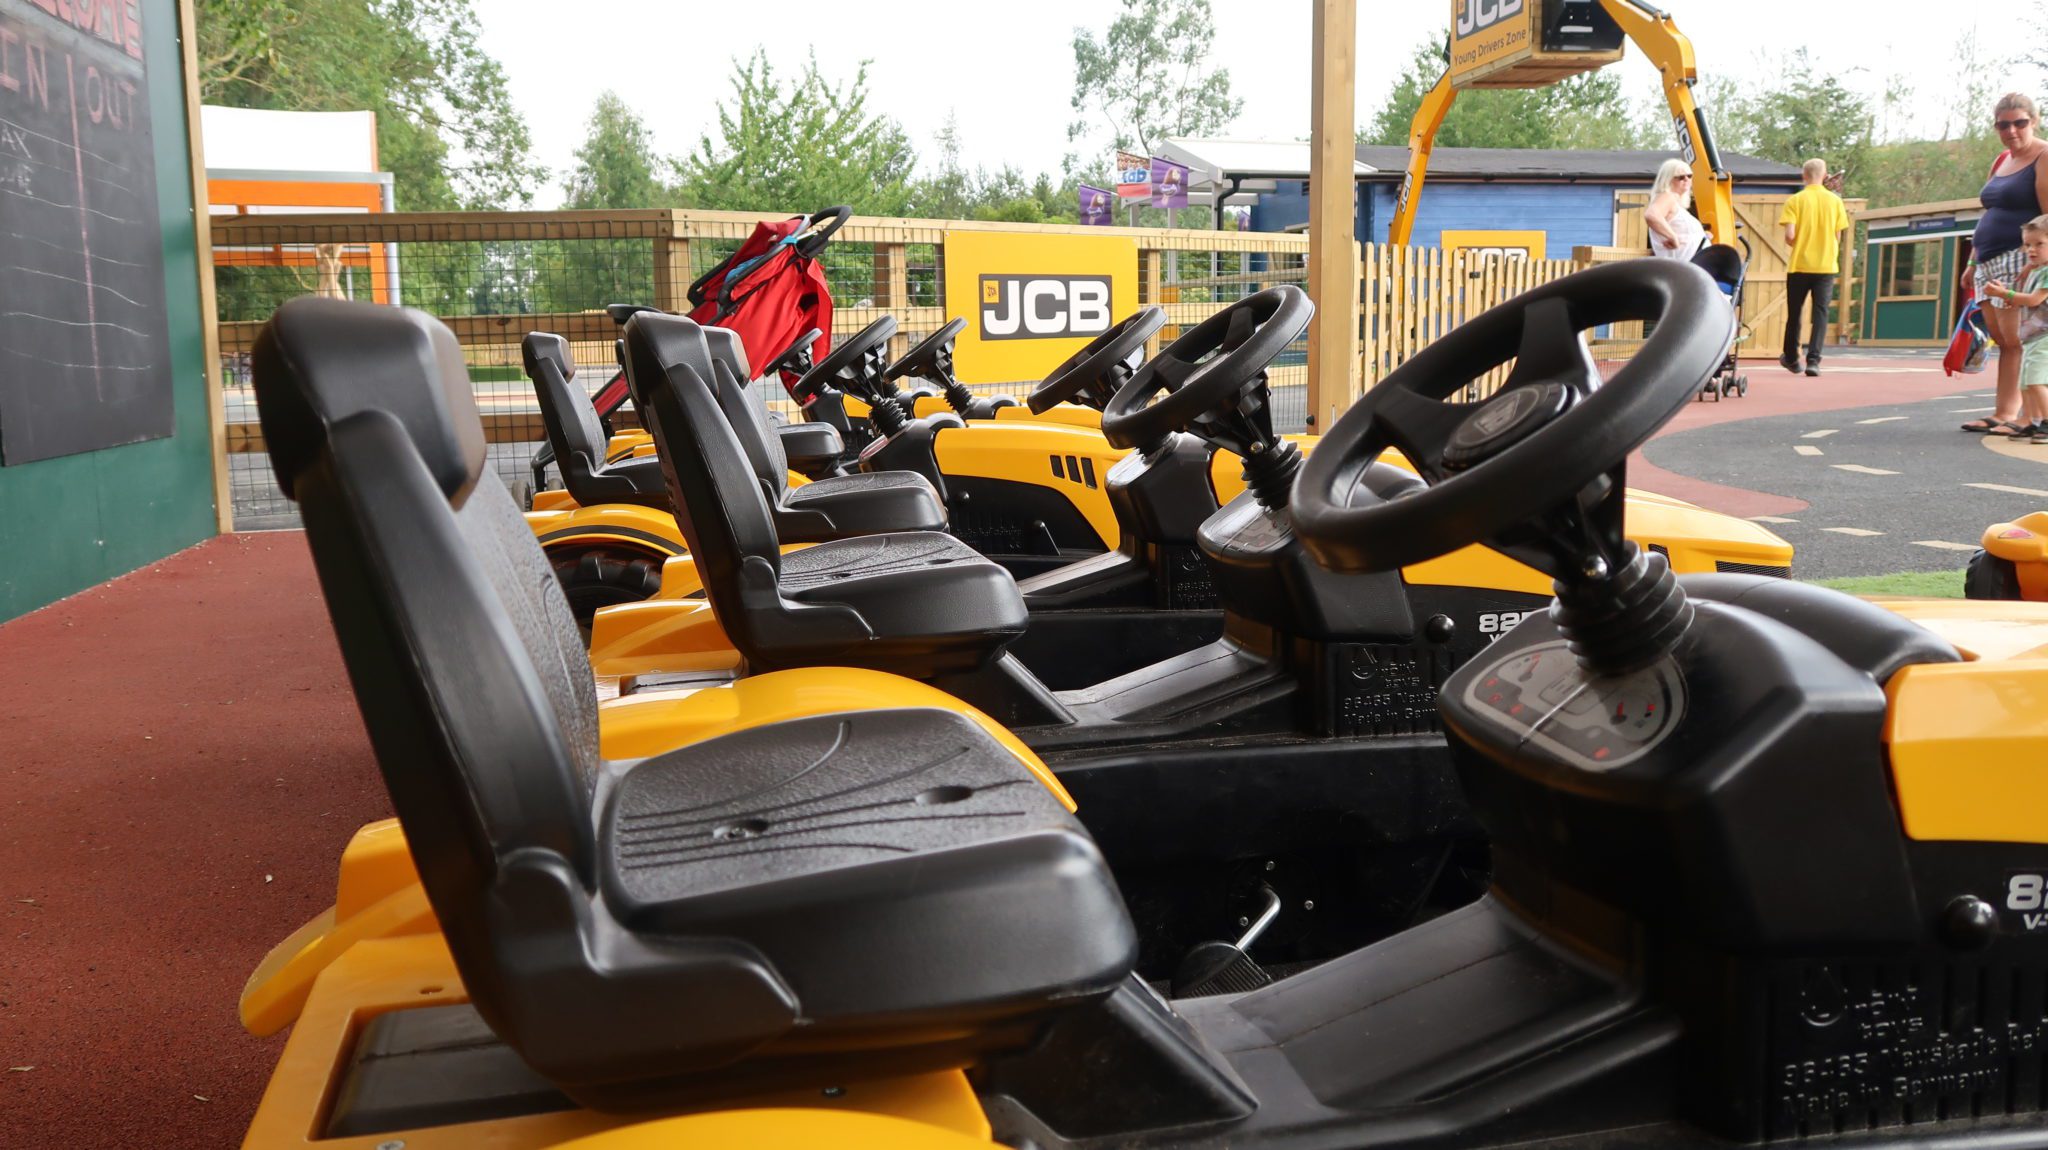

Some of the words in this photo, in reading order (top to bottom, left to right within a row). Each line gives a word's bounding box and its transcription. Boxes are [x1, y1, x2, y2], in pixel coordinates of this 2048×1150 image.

[1455, 50, 1477, 66] Young
[1478, 38, 1504, 57] Drivers
[1506, 29, 1527, 46] Zone
[983, 280, 1110, 335] JCB
[2006, 874, 2048, 910] 8
[2023, 912, 2048, 930] V-
